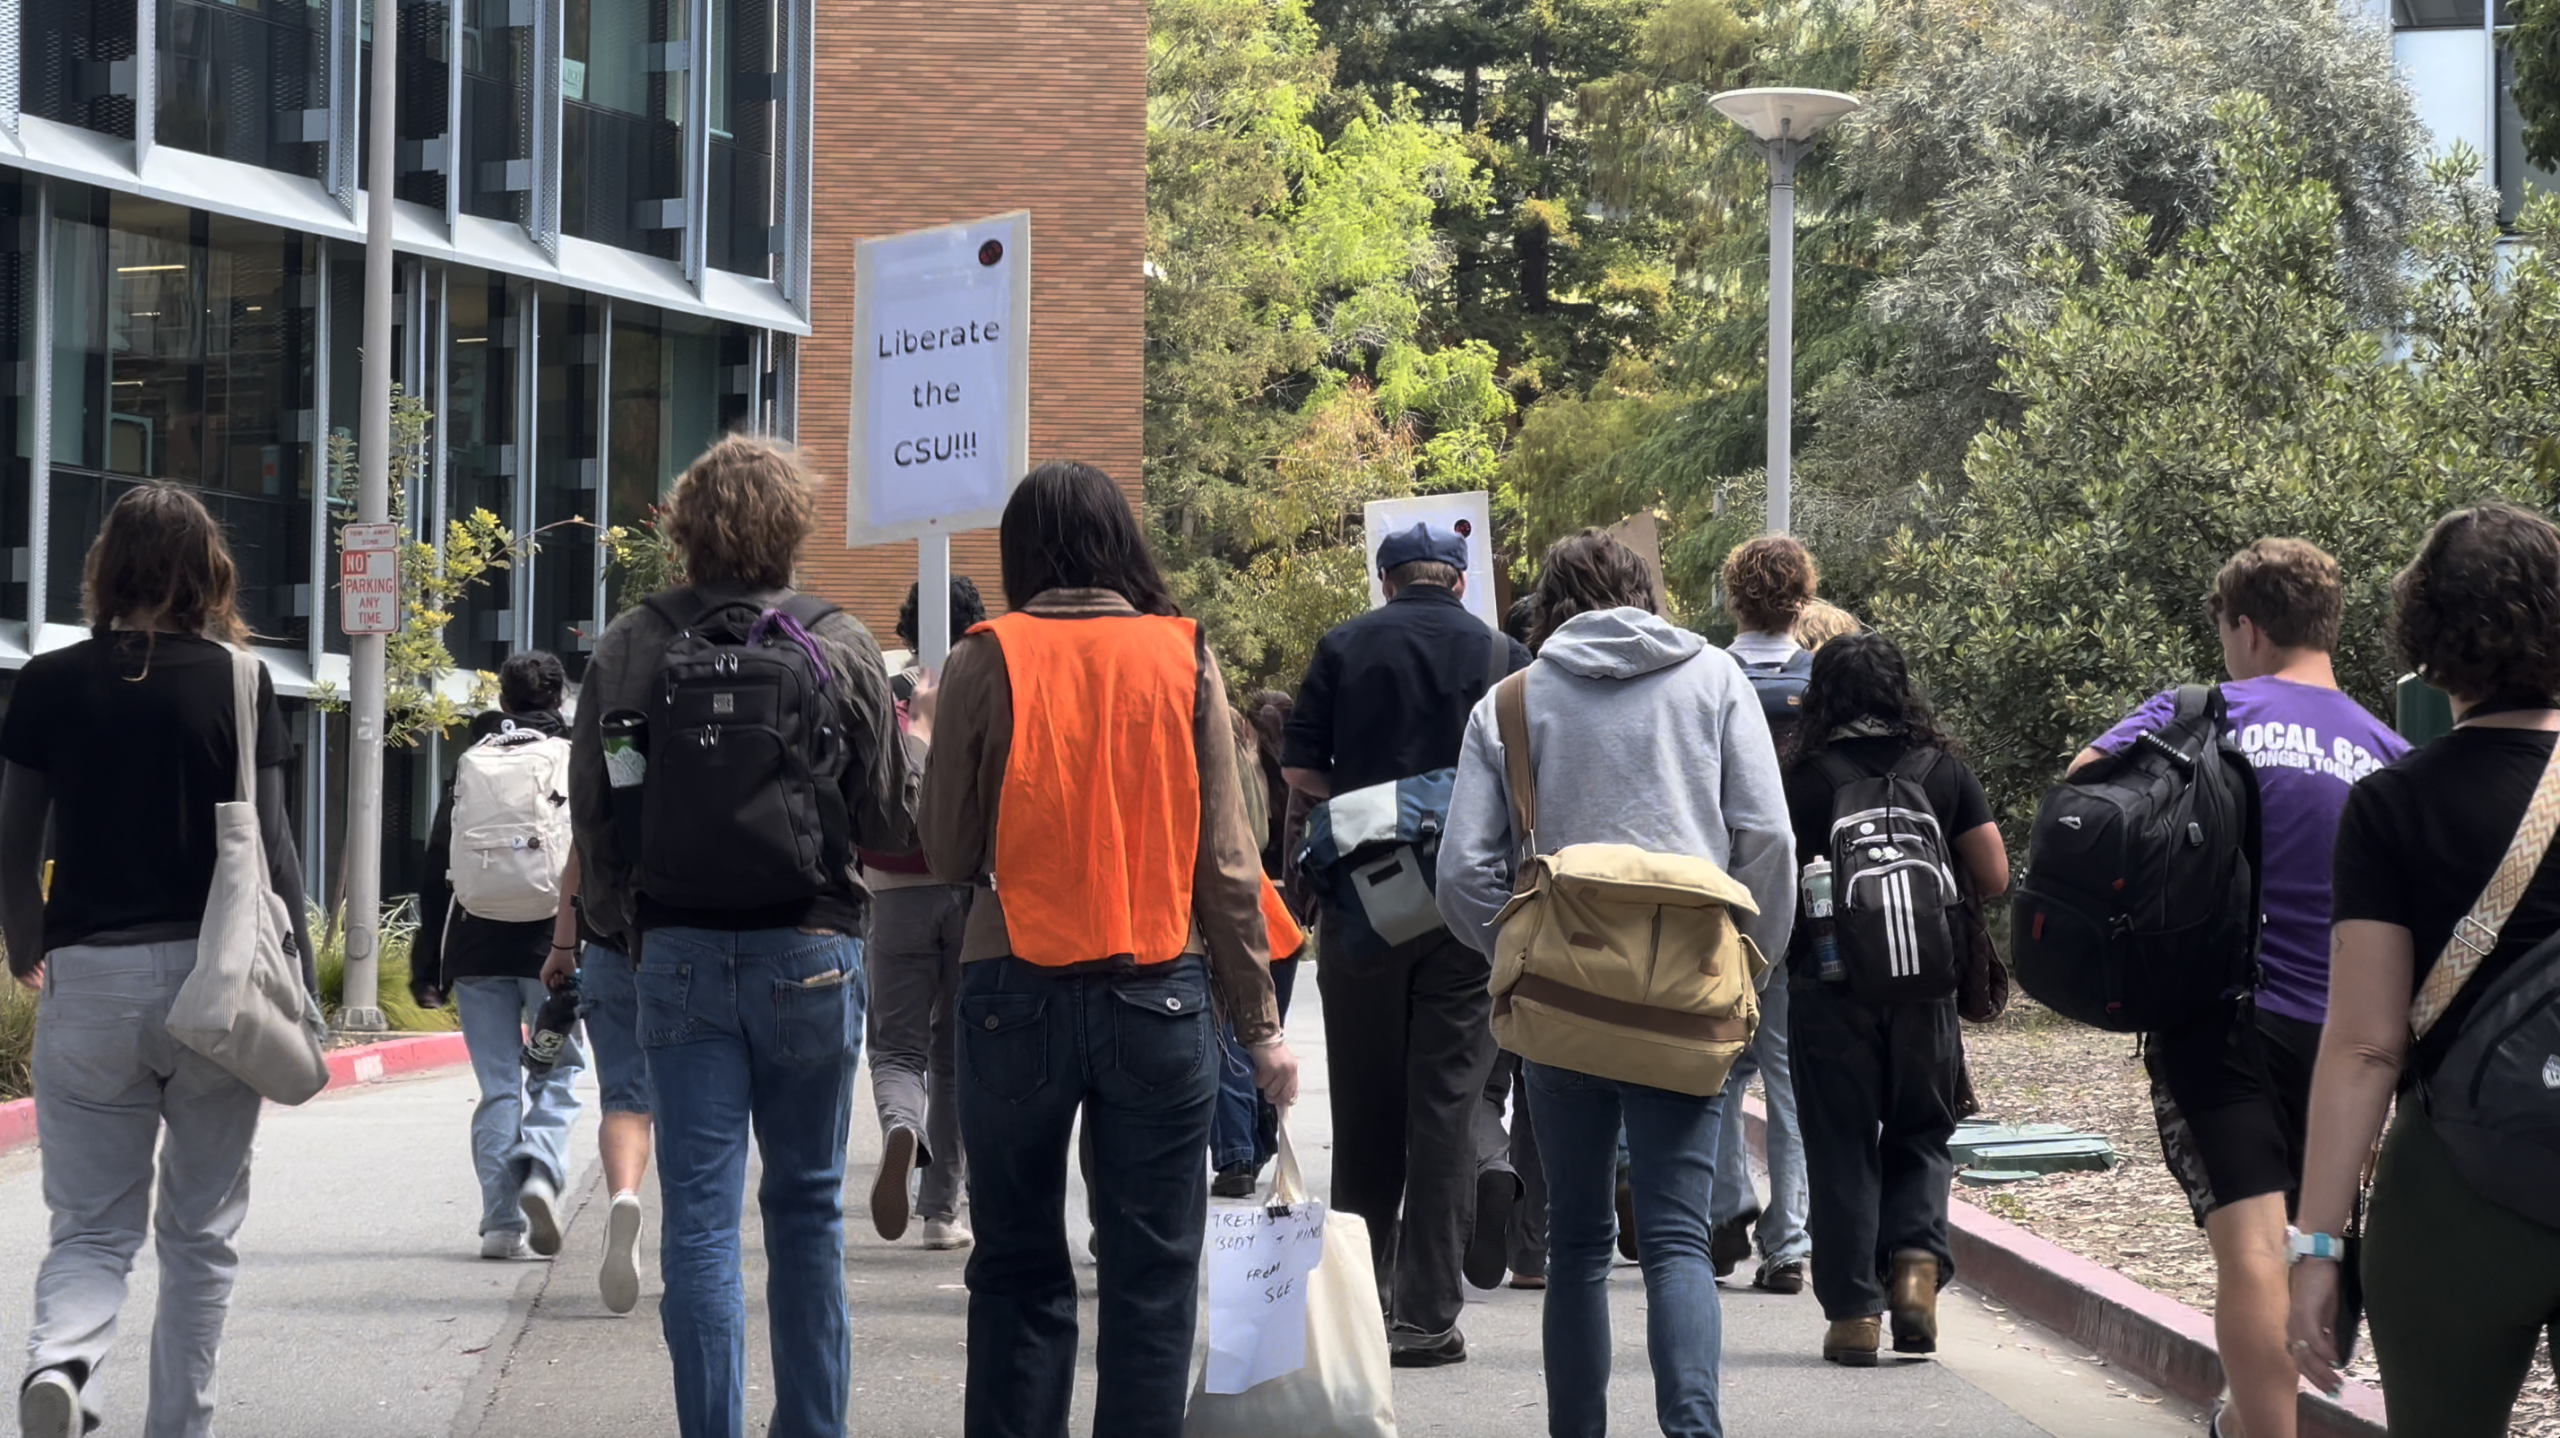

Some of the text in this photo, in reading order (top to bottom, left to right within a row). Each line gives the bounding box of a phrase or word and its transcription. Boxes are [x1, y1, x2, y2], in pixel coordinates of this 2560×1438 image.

[878, 320, 1000, 358] Liberate
[912, 380, 961, 408] the
[894, 431, 977, 468] CSU!!!
[346, 554, 364, 572] NO
[345, 579, 393, 594] PARKING
[359, 597, 380, 609] ANY
[359, 612, 382, 624] TIME
[2245, 750, 2310, 769] RONGER
[1215, 1234, 1256, 1251] BODY
[1246, 1261, 1281, 1282] FROM
